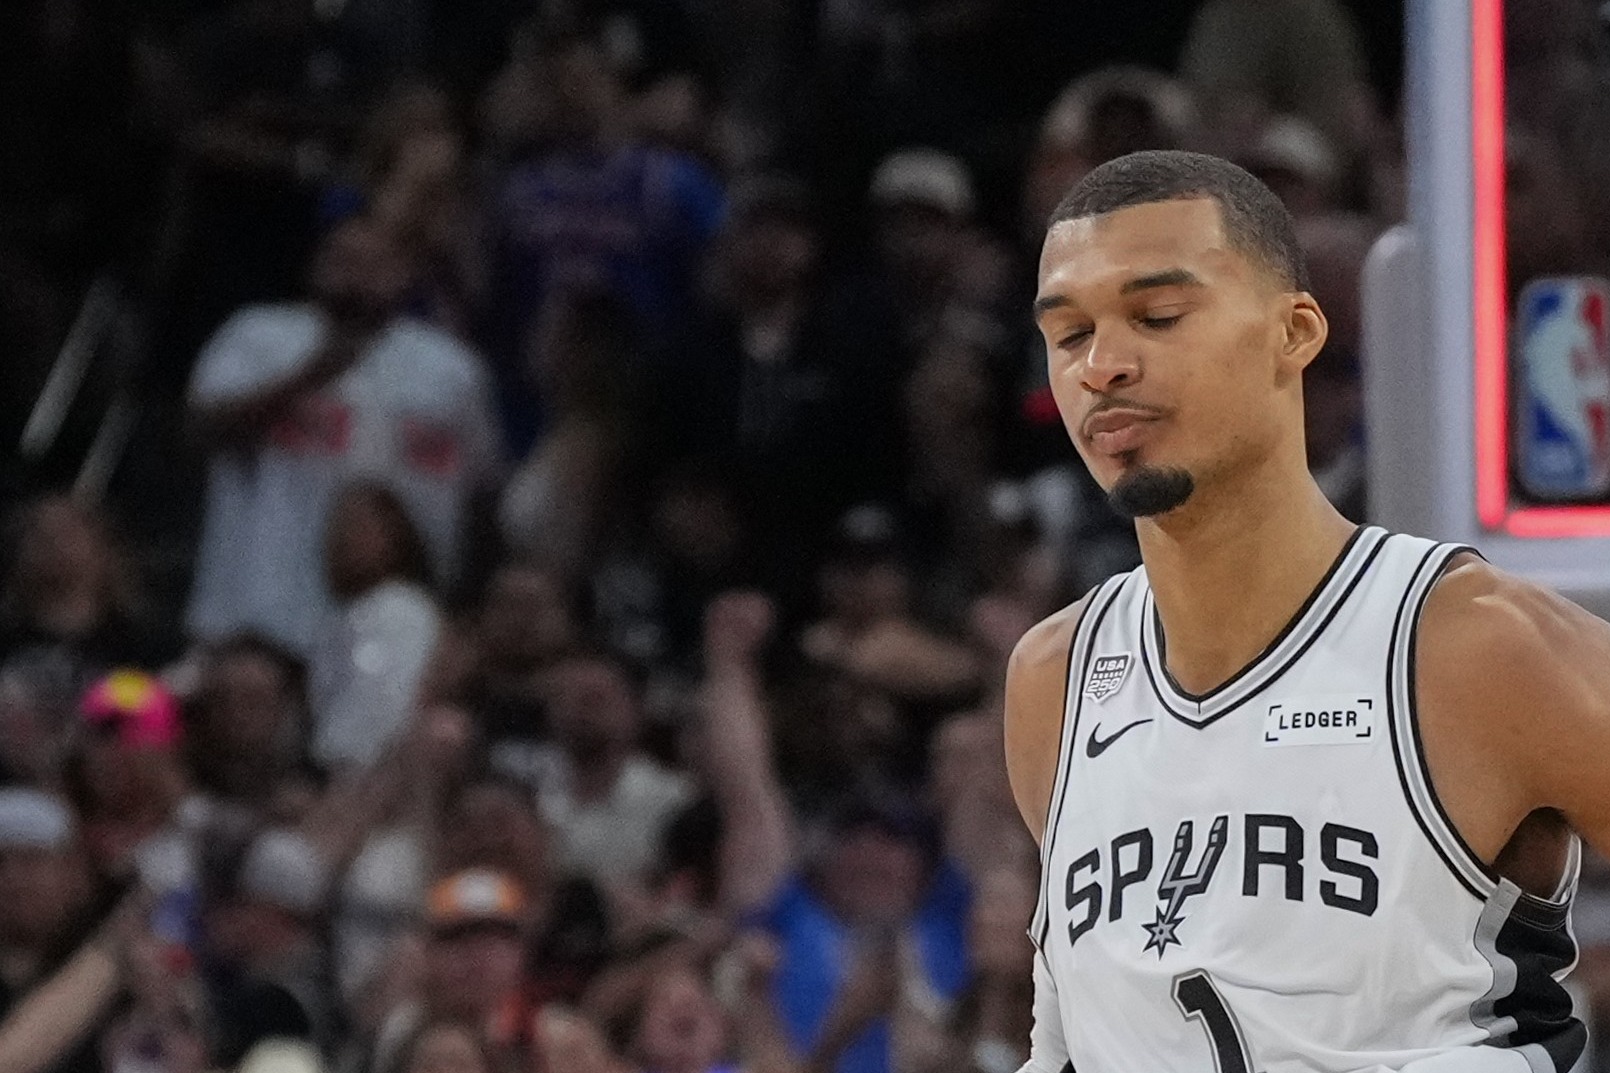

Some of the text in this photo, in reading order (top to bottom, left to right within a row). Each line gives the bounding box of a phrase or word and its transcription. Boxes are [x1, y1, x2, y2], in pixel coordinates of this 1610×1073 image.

[1096, 659, 1125, 671] USA
[1087, 677, 1121, 692] 250
[1278, 710, 1357, 730] LEDGER
[1065, 813, 1379, 961] SPURS
